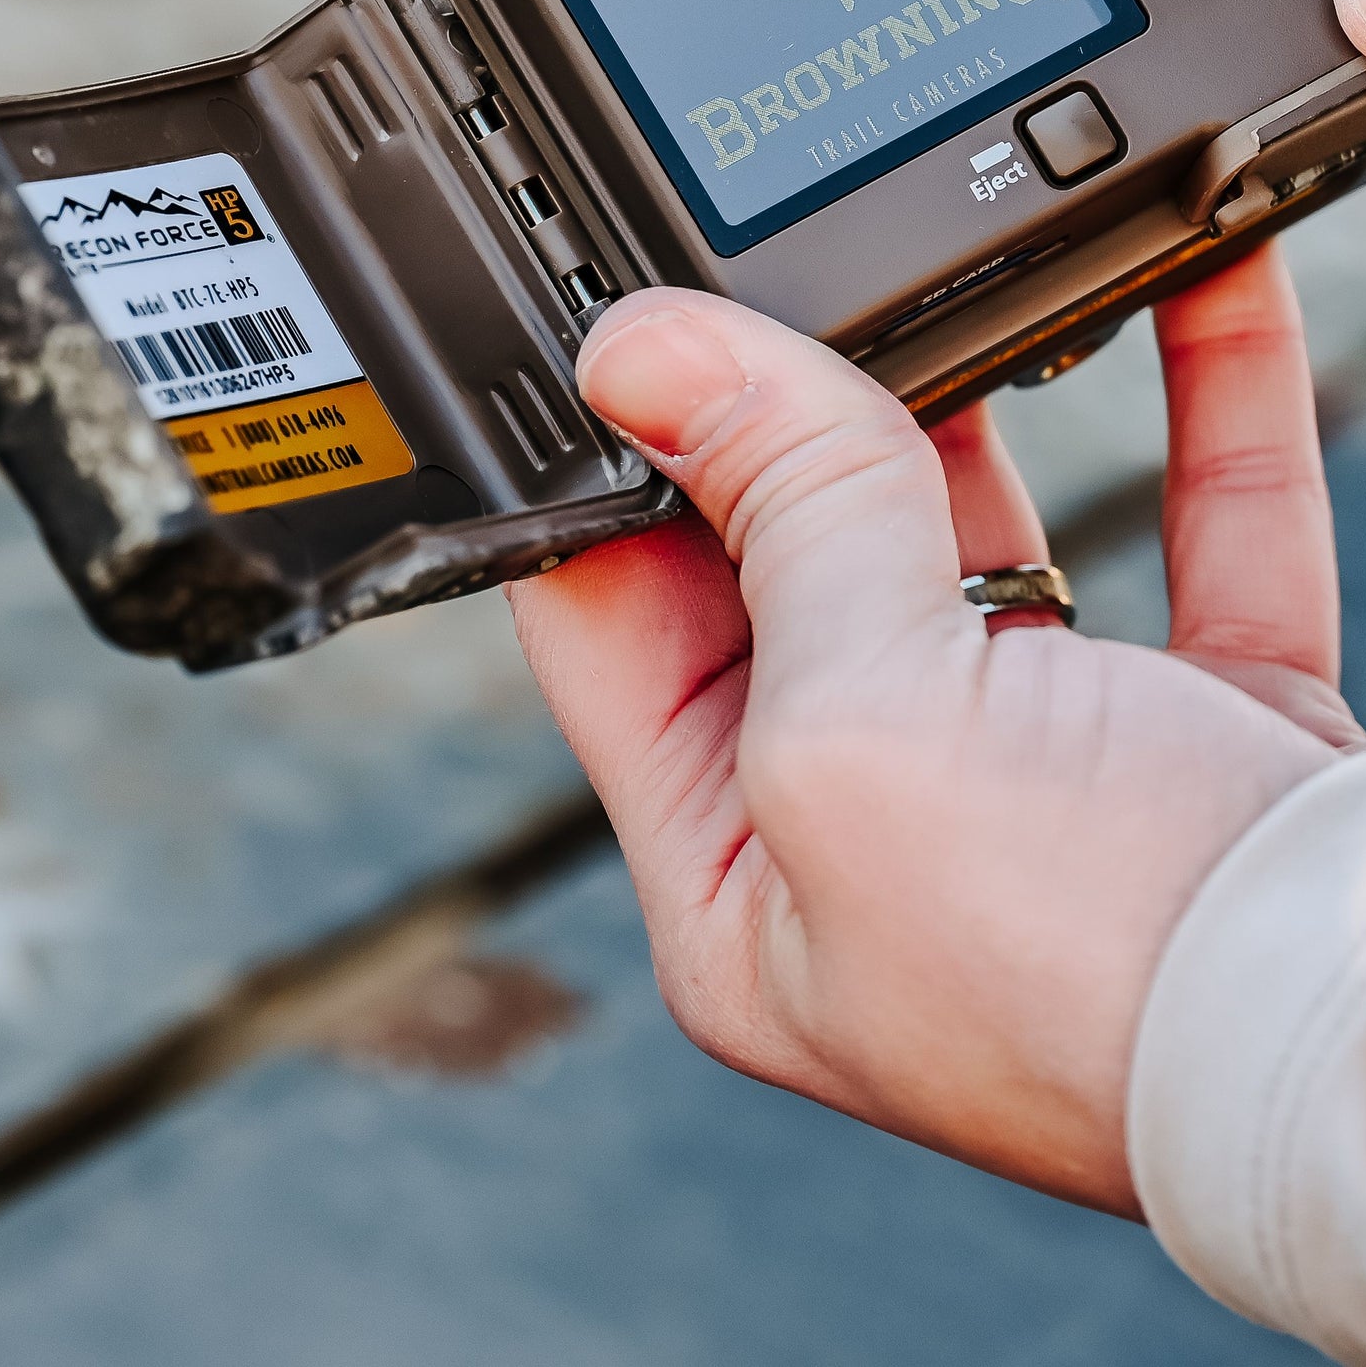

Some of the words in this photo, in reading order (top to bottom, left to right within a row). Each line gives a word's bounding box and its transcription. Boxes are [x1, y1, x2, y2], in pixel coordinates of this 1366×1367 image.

[805, 116, 884, 168] TRAIL
[891, 47, 1006, 122] CAMERAS
[969, 160, 1028, 202] Eject
[206, 189, 239, 212] HP
[136, 219, 219, 248] FORCE
[225, 208, 254, 239] 5
[922, 288, 947, 305] SD
[953, 256, 1005, 288] CARD
[276, 404, 347, 437] 618-4496
